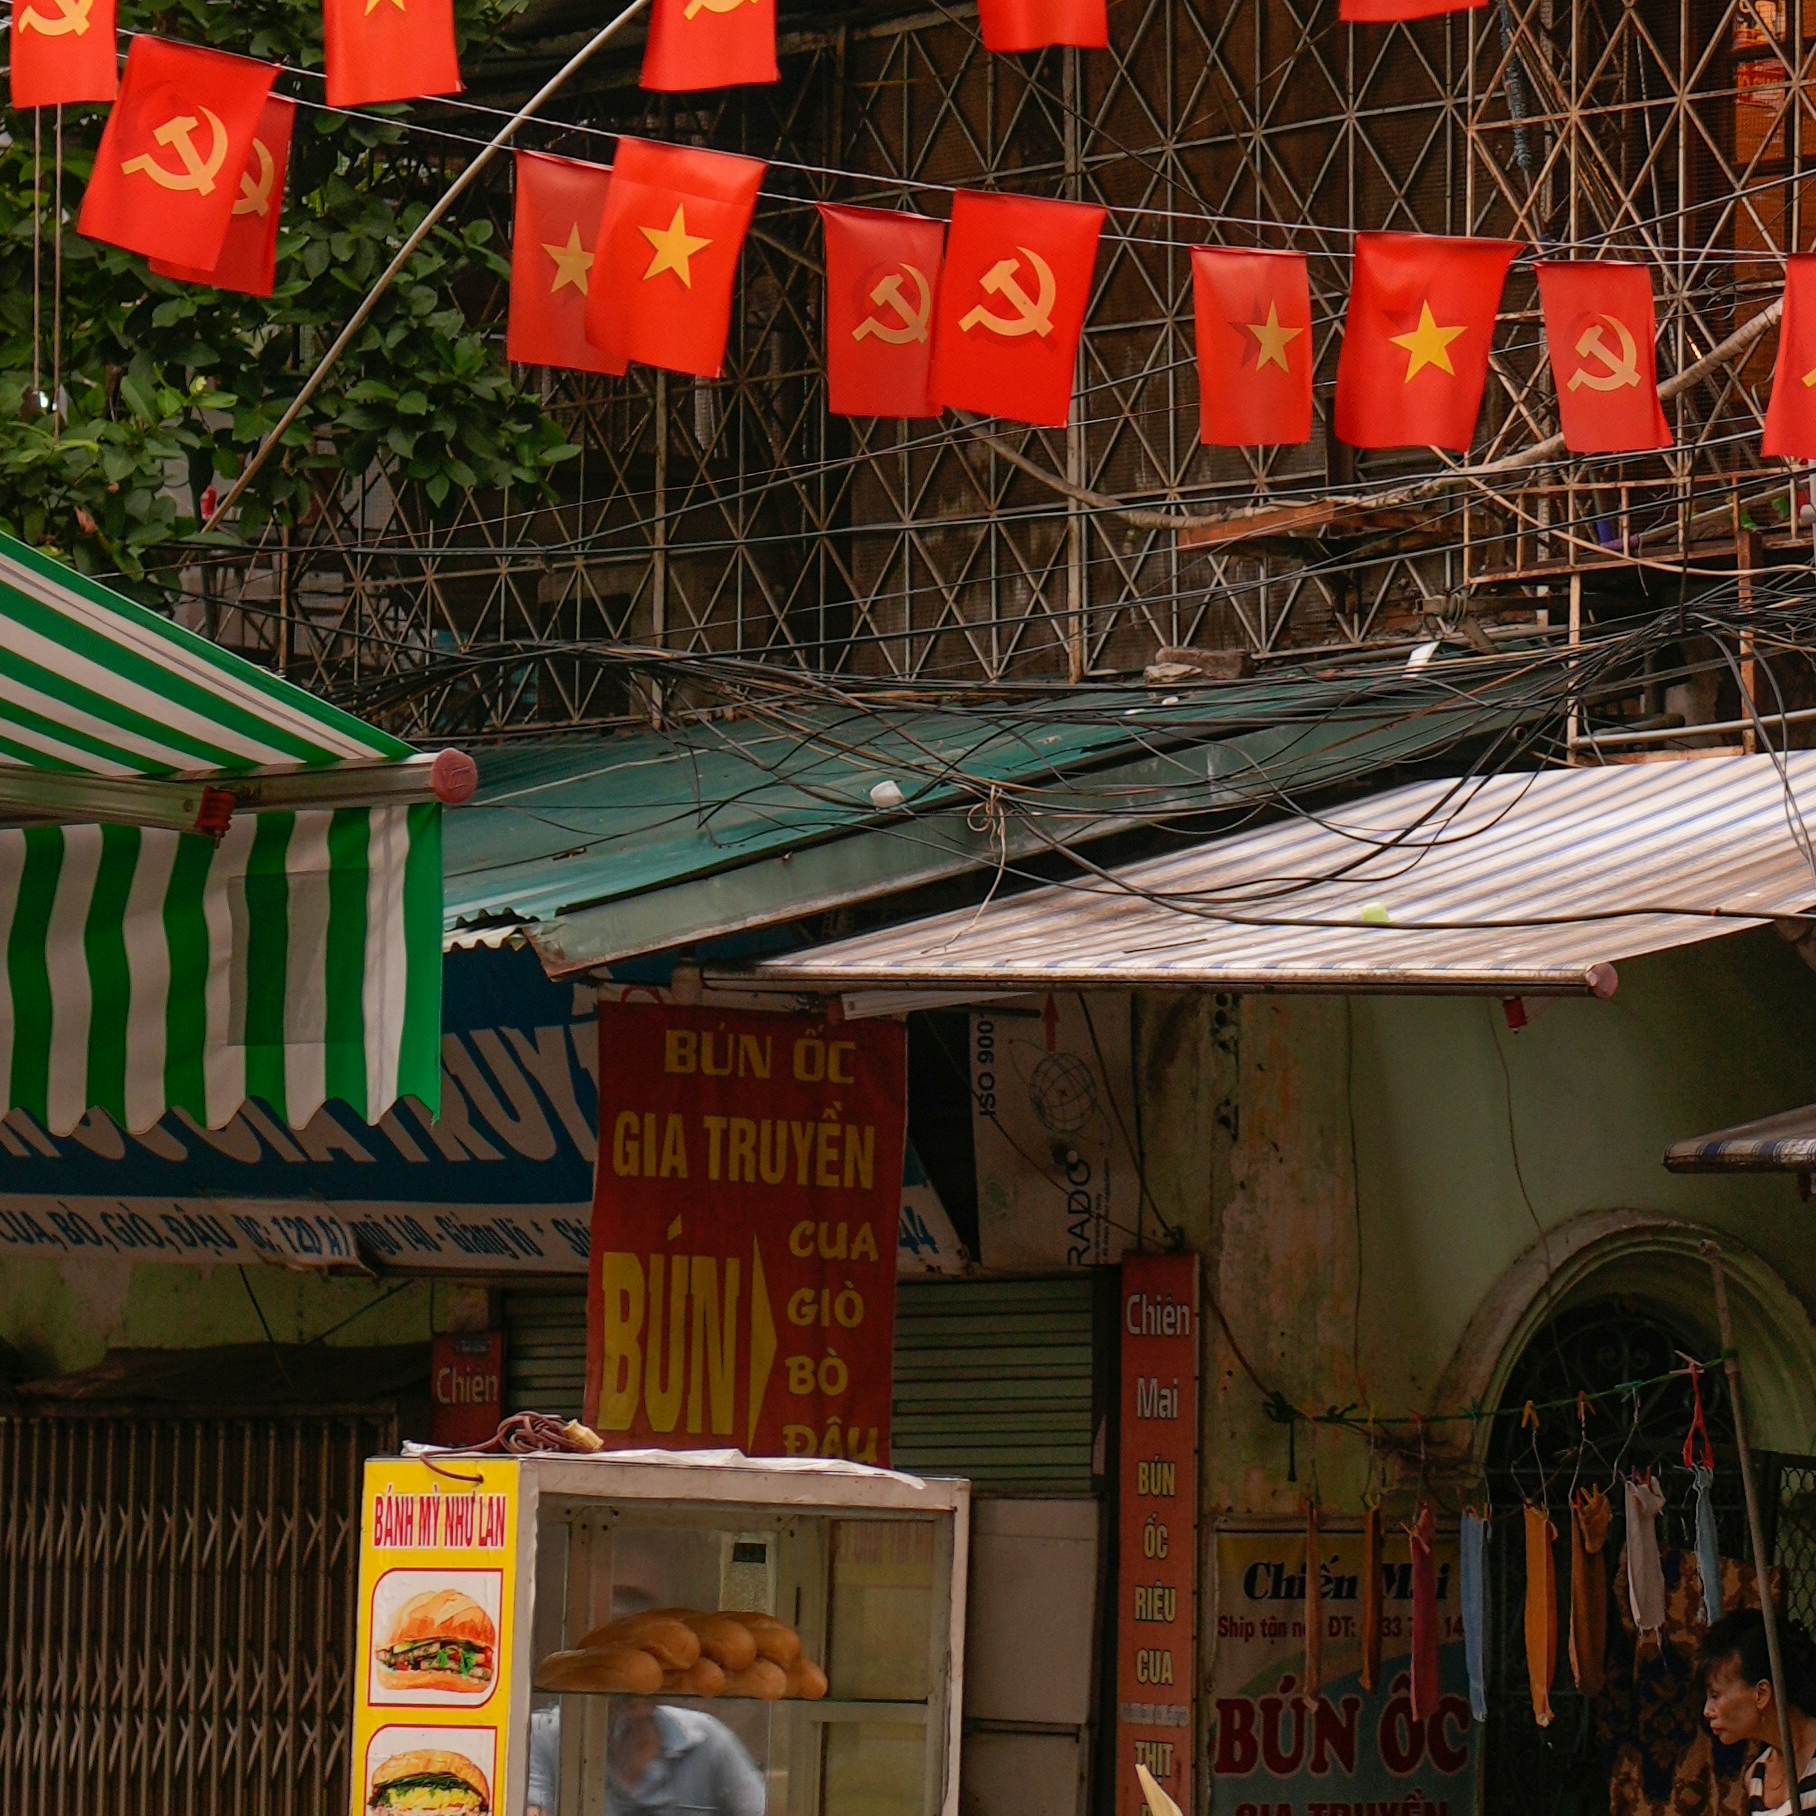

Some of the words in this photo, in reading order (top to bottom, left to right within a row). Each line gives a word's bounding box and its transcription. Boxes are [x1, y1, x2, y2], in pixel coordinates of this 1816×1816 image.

[663, 1022, 773, 1080] BÚN
[792, 1023, 856, 1084] ỐC
[611, 1110, 689, 1179] GIA
[703, 1101, 877, 1191] TRUYỀN
[787, 1219, 880, 1263] CUA
[597, 1213, 741, 1436] BÚN
[786, 1281, 866, 1330] GIÒ
[785, 1346, 849, 1397] BÒ
[1136, 1376, 1179, 1420] Mai
[1136, 1456, 1176, 1497] BÚN
[374, 1484, 414, 1547] BÁNH
[444, 1489, 476, 1548] NHƯ
[478, 1495, 506, 1547] LAN
[1142, 1511, 1168, 1559] ỐC
[1134, 1581, 1177, 1623] RIÊU
[1217, 1616, 1256, 1642] Ship
[1136, 1649, 1174, 1686] CUA
[1214, 1675, 1361, 1774] BÚN
